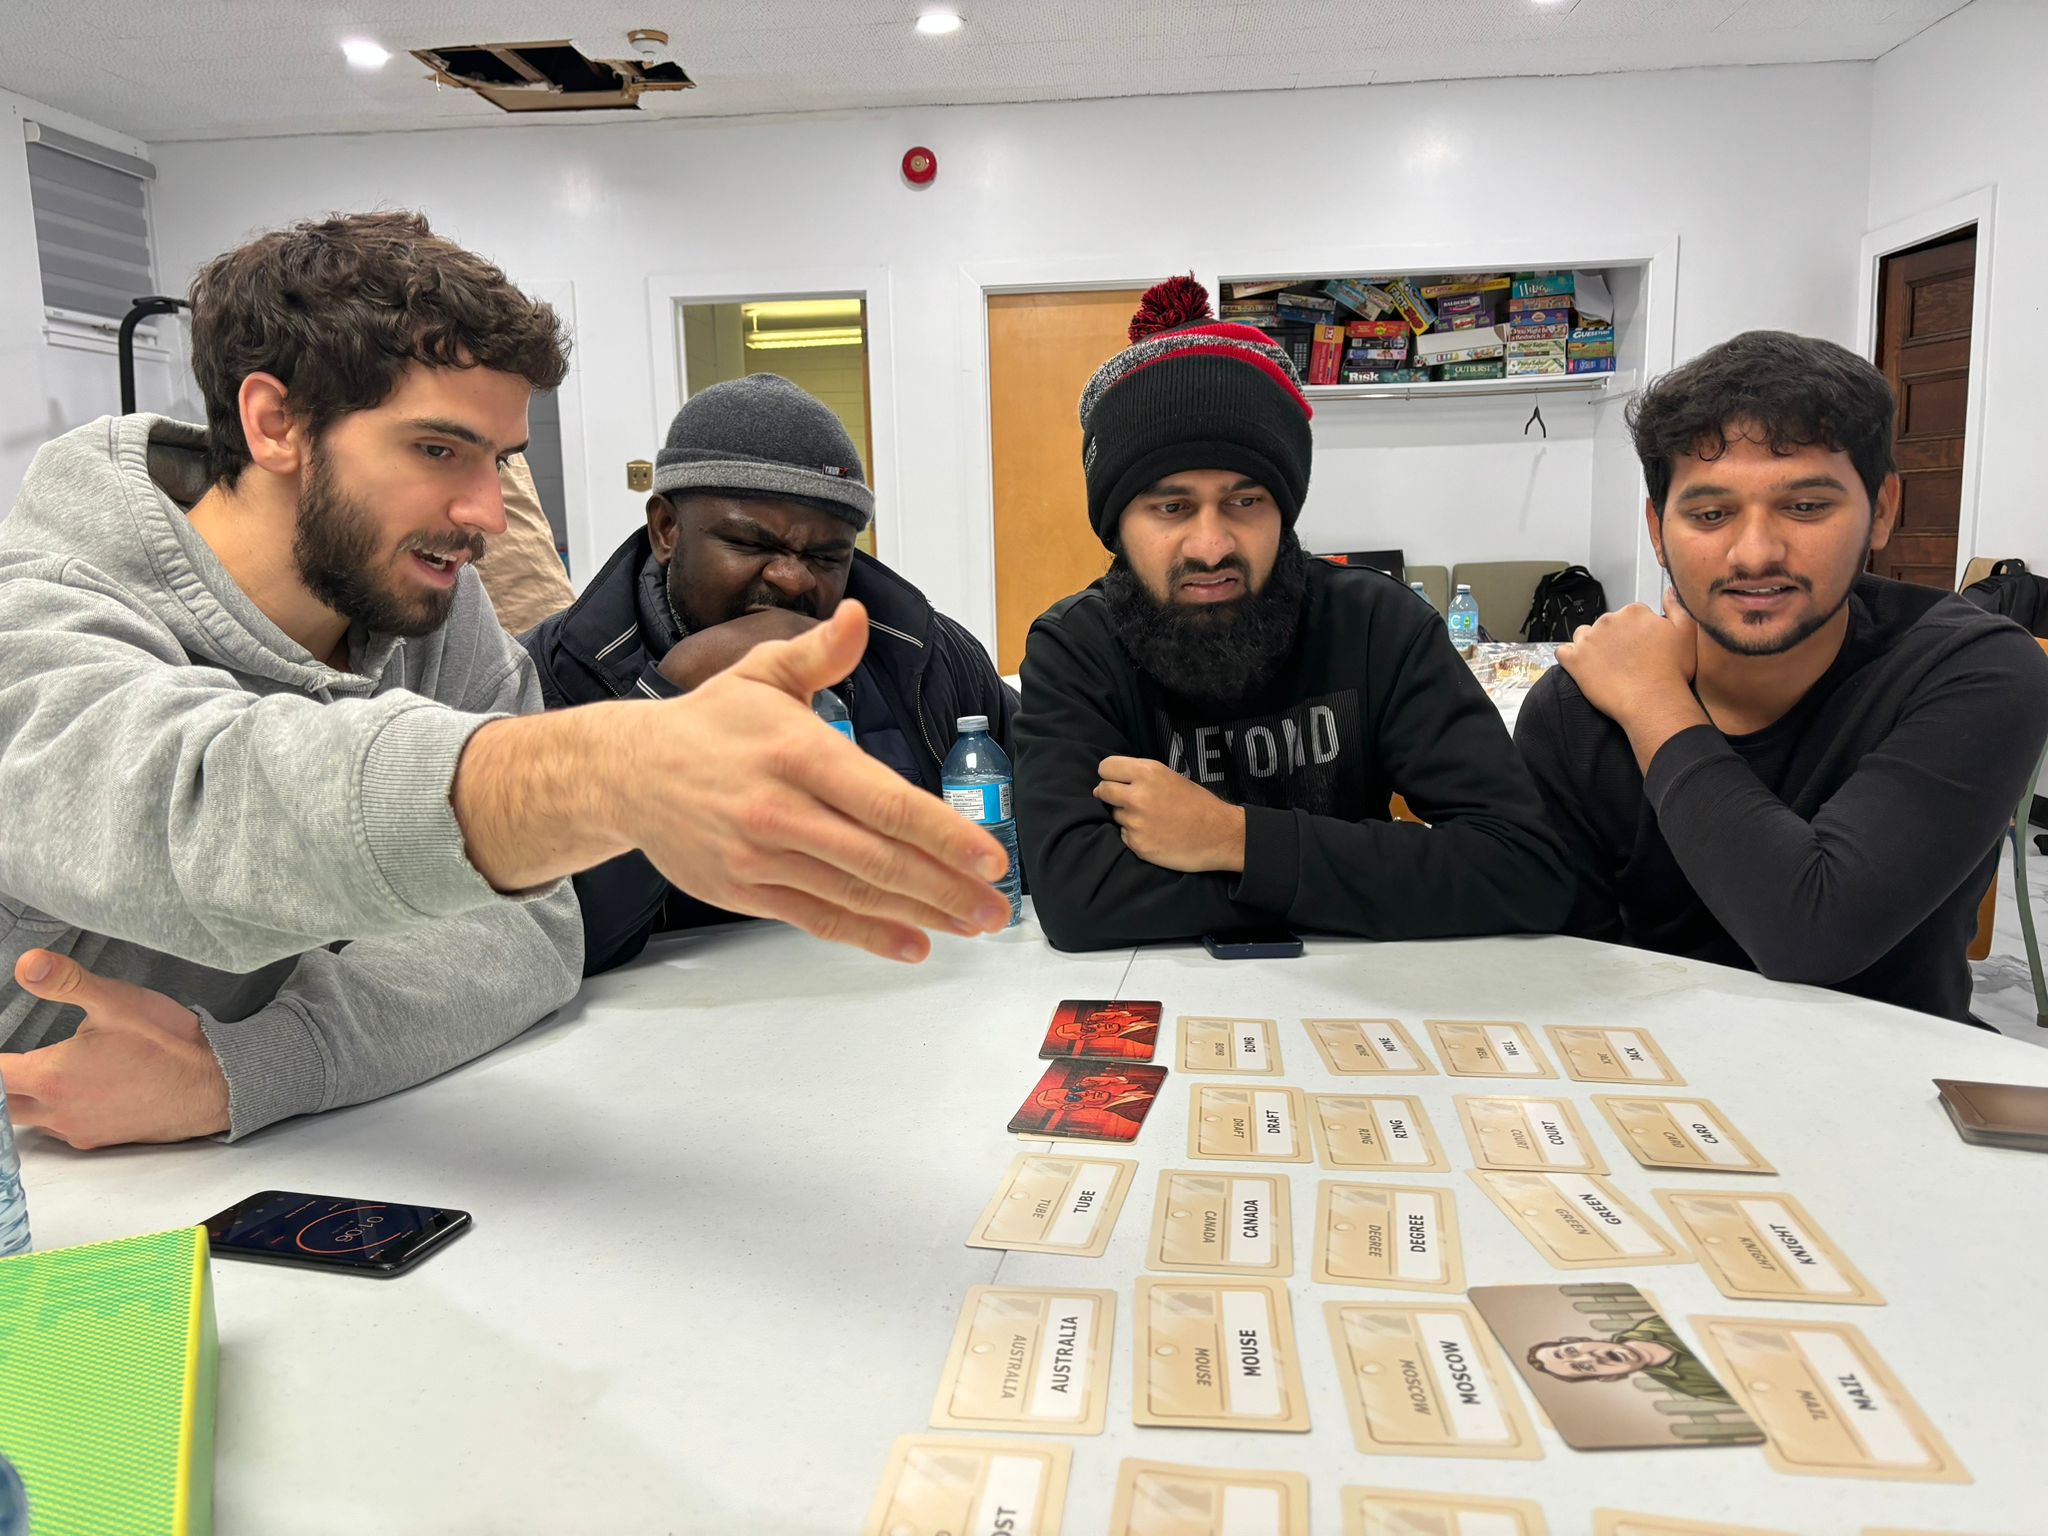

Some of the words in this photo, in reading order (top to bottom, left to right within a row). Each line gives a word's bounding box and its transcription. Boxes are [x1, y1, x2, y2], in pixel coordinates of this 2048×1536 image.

[1455, 365, 1491, 373] OUTBURST
[1169, 706, 1340, 783] BEOND
[1243, 1036, 1256, 1053] BOMB
[1378, 1037, 1398, 1052] MINE
[1502, 1041, 1520, 1056] WELL
[1624, 1047, 1644, 1062] JACK
[1233, 1118, 1244, 1139] DRAFT
[1266, 1109, 1280, 1134] DRAFT
[1358, 1127, 1371, 1145] RING
[1391, 1119, 1409, 1139] RING
[1541, 1120, 1566, 1146] COURT
[1691, 1122, 1719, 1146] CARD
[1509, 1128, 1529, 1150] COURT
[1662, 1130, 1685, 1149] CARD
[1032, 1199, 1051, 1220] TUBE
[1073, 1190, 1096, 1214] TUBE
[1578, 1192, 1622, 1226] GREEN
[1202, 1210, 1217, 1244] CANADA
[1243, 1199, 1259, 1239] CANADA
[1409, 1214, 1427, 1253] DEGREE
[1555, 1207, 1590, 1236] GREEN
[1369, 1224, 1382, 1258] DEGREE
[1738, 1236, 1776, 1272] KNIGHT
[1769, 1222, 1817, 1266] KNIGHT
[1001, 1333, 1027, 1399] AUSTRALIA
[1051, 1316, 1079, 1394] AUSTRALIA
[1195, 1347, 1212, 1387] MOUSE
[1240, 1329, 1262, 1377] MOUSE
[1400, 1359, 1431, 1416] MOSCOW
[1439, 1340, 1481, 1406] MOSCOW
[1795, 1388, 1823, 1422] MAIL
[1837, 1372, 1877, 1412] MAIL
